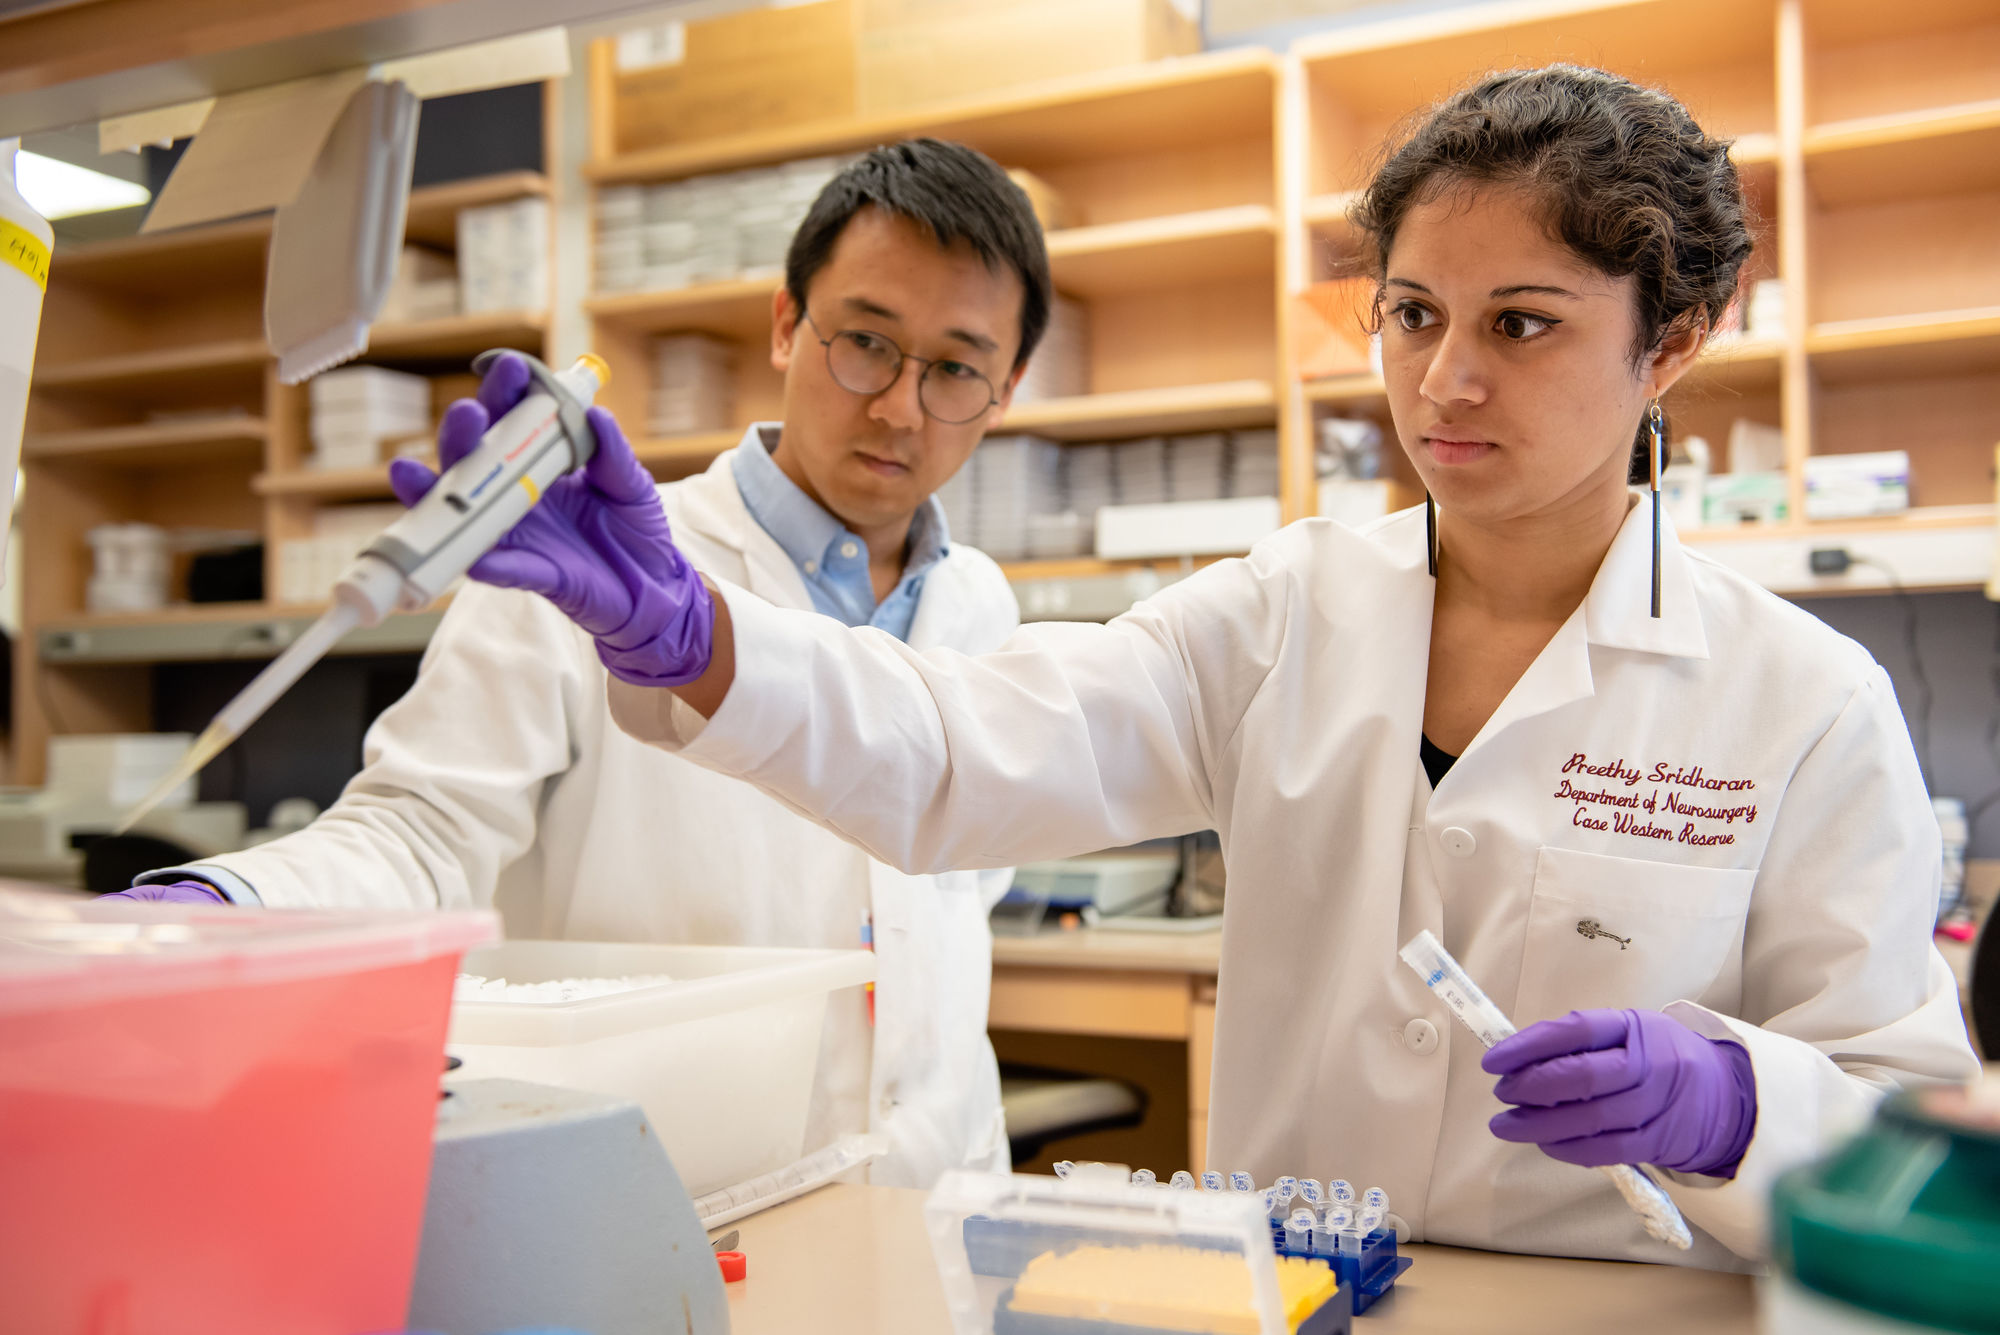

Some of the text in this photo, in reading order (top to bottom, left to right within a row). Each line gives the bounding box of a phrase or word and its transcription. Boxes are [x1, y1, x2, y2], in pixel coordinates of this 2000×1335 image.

[1561, 752, 1755, 791] Preethy Sridharan
[1554, 779, 1758, 824] Department of Neurosurgery
[1572, 806, 1735, 847] Case Western Reserve
